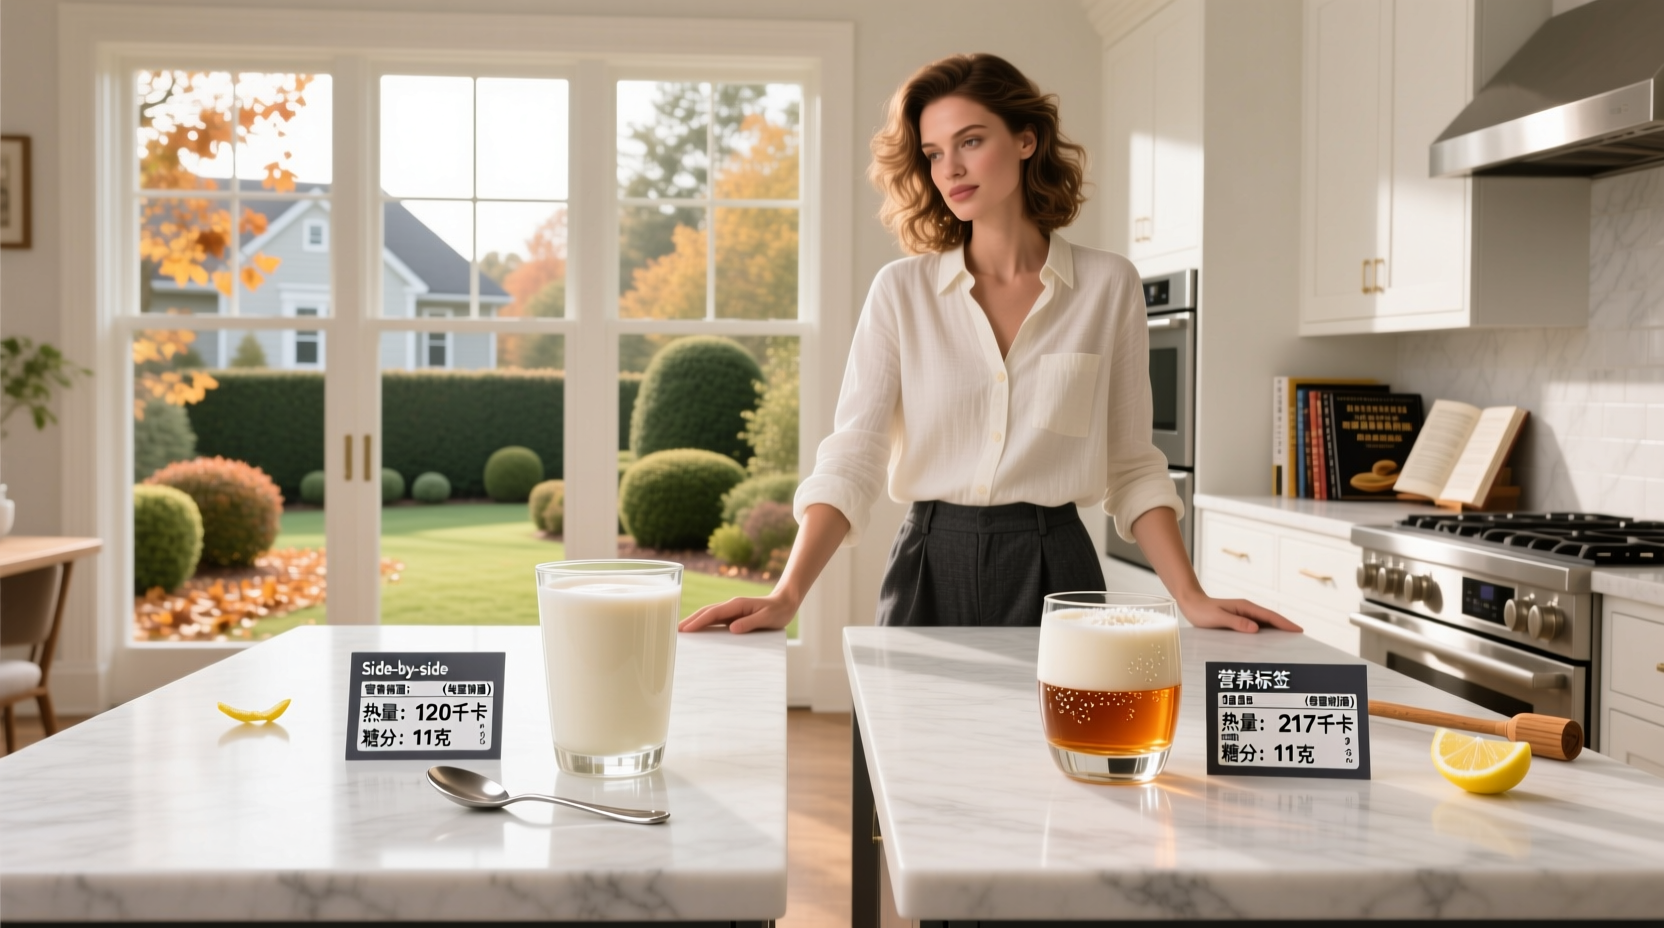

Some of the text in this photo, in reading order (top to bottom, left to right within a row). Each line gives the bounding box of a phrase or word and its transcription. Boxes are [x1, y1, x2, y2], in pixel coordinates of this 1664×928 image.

[362, 660, 449, 679] Side-by-side
[1218, 669, 1291, 690] 营养标签
